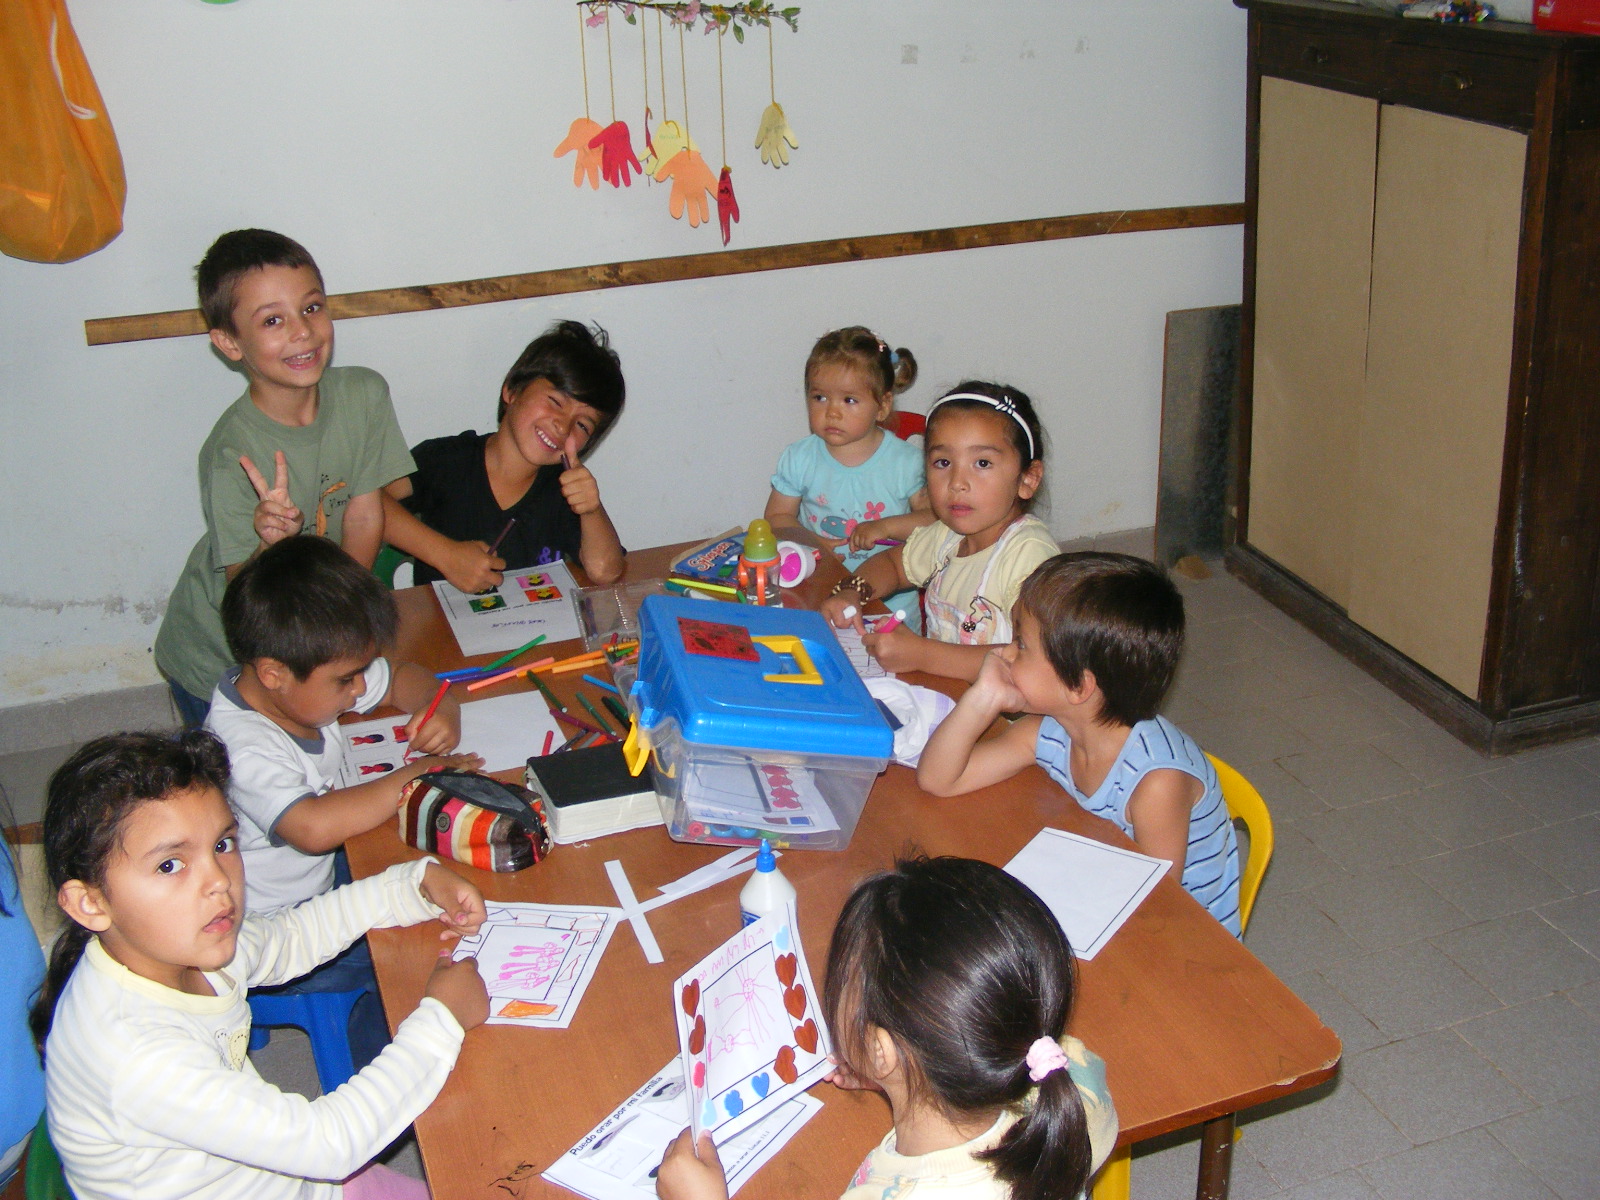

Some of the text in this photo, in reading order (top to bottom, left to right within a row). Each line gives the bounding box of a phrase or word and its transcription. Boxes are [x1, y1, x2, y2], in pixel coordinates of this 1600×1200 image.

[569, 1077, 663, 1156] Puedo orar por mi familia
